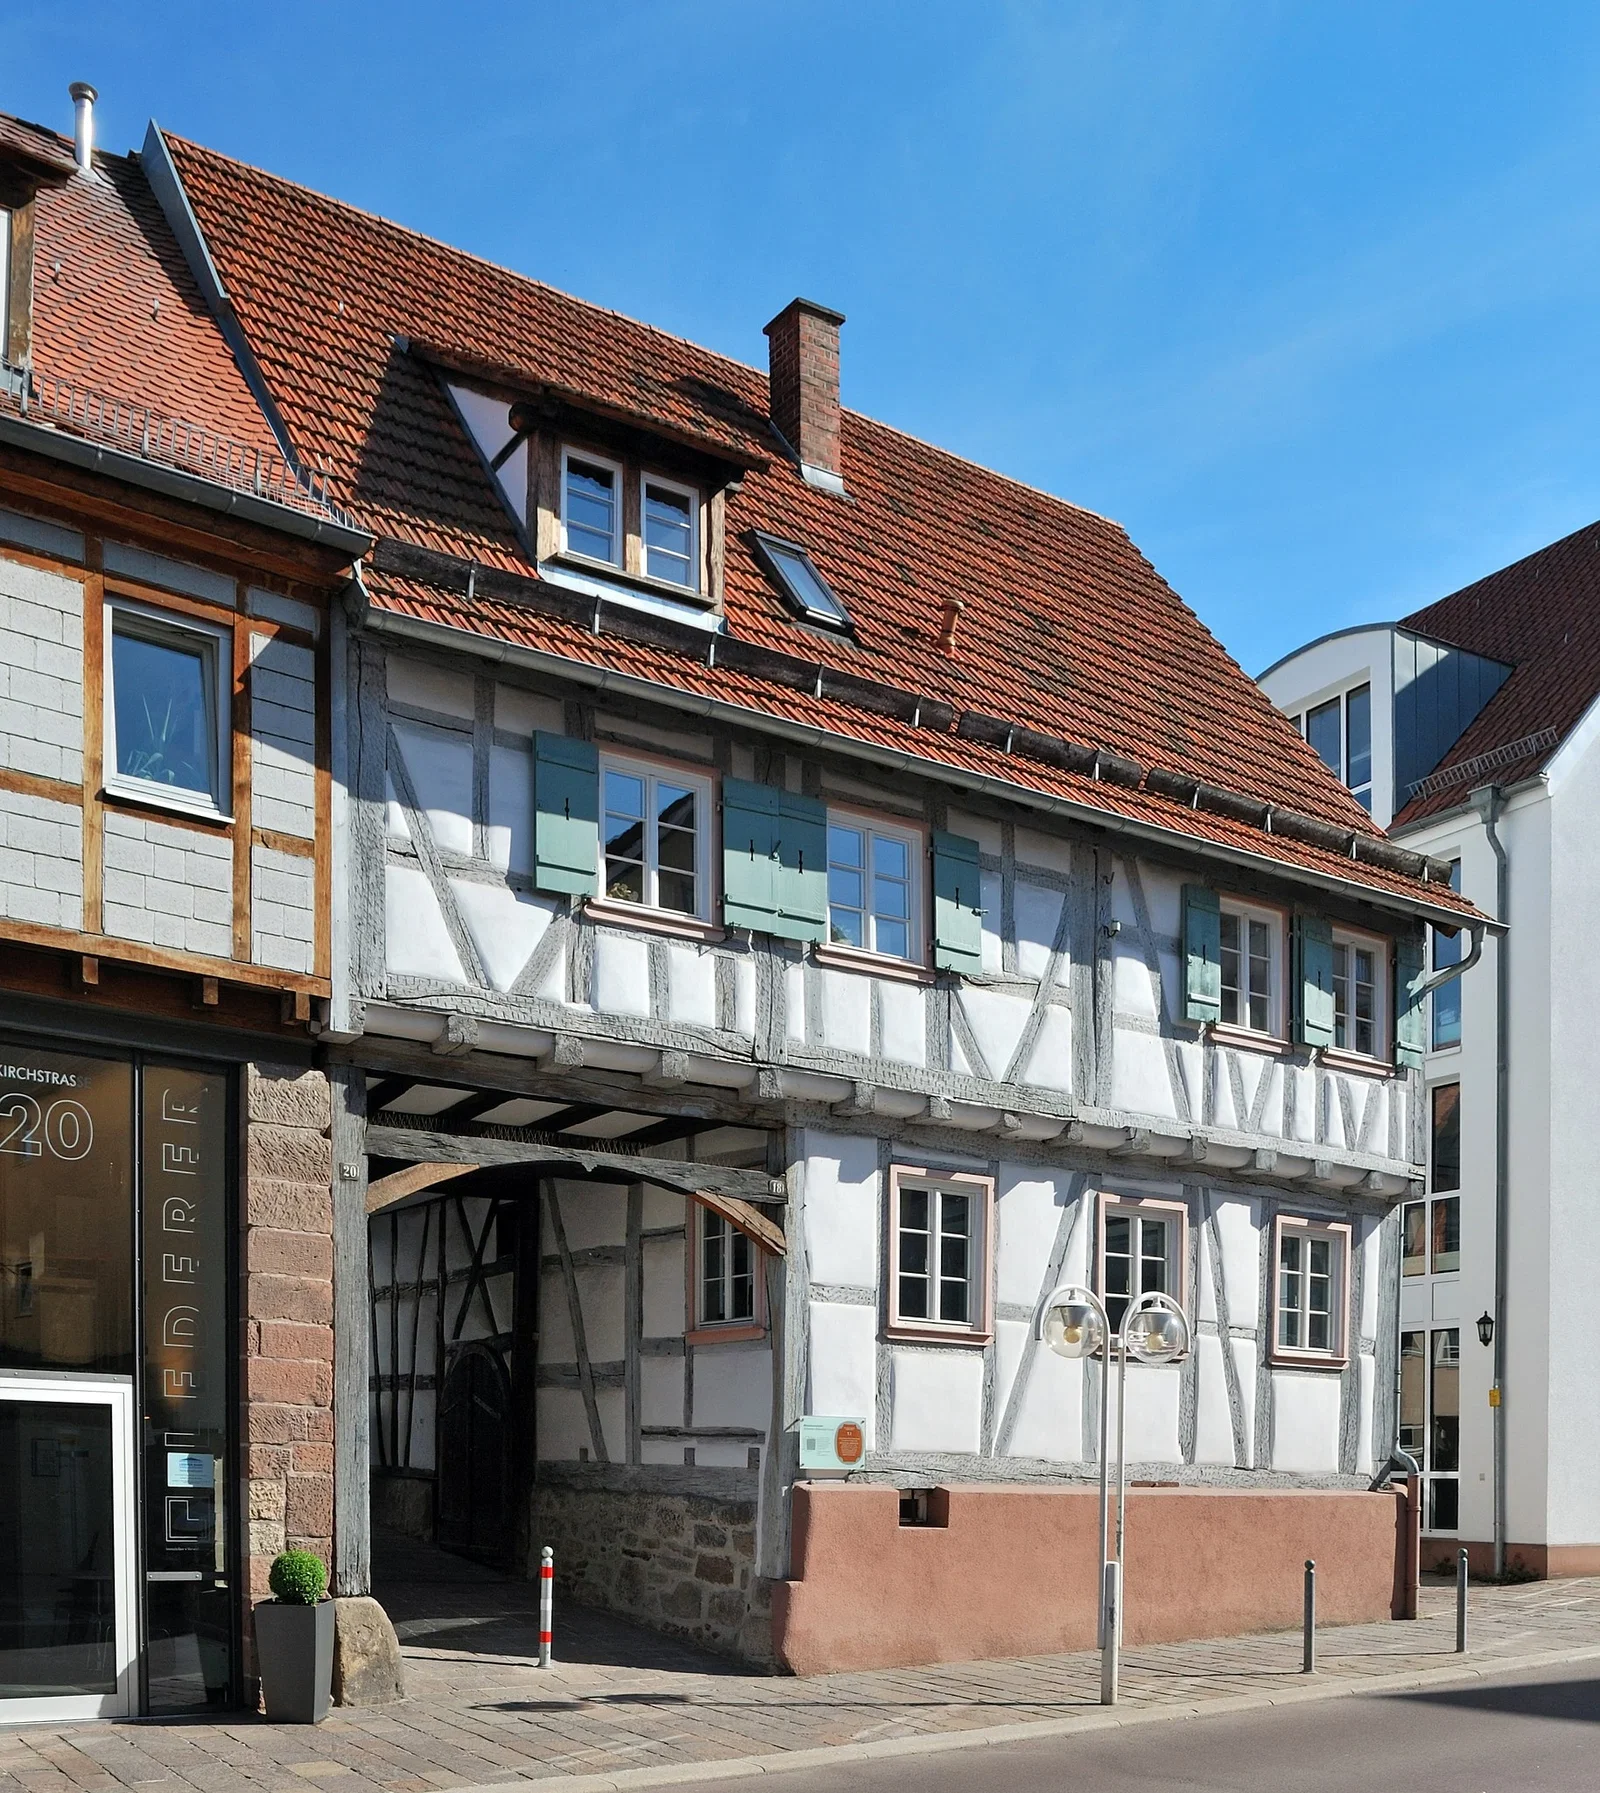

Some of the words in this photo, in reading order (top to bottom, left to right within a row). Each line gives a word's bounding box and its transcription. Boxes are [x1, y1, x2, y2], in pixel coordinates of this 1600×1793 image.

[0, 1092, 93, 1161] 20
[343, 1165, 357, 1178] 20
[772, 1182, 782, 1194] 18
